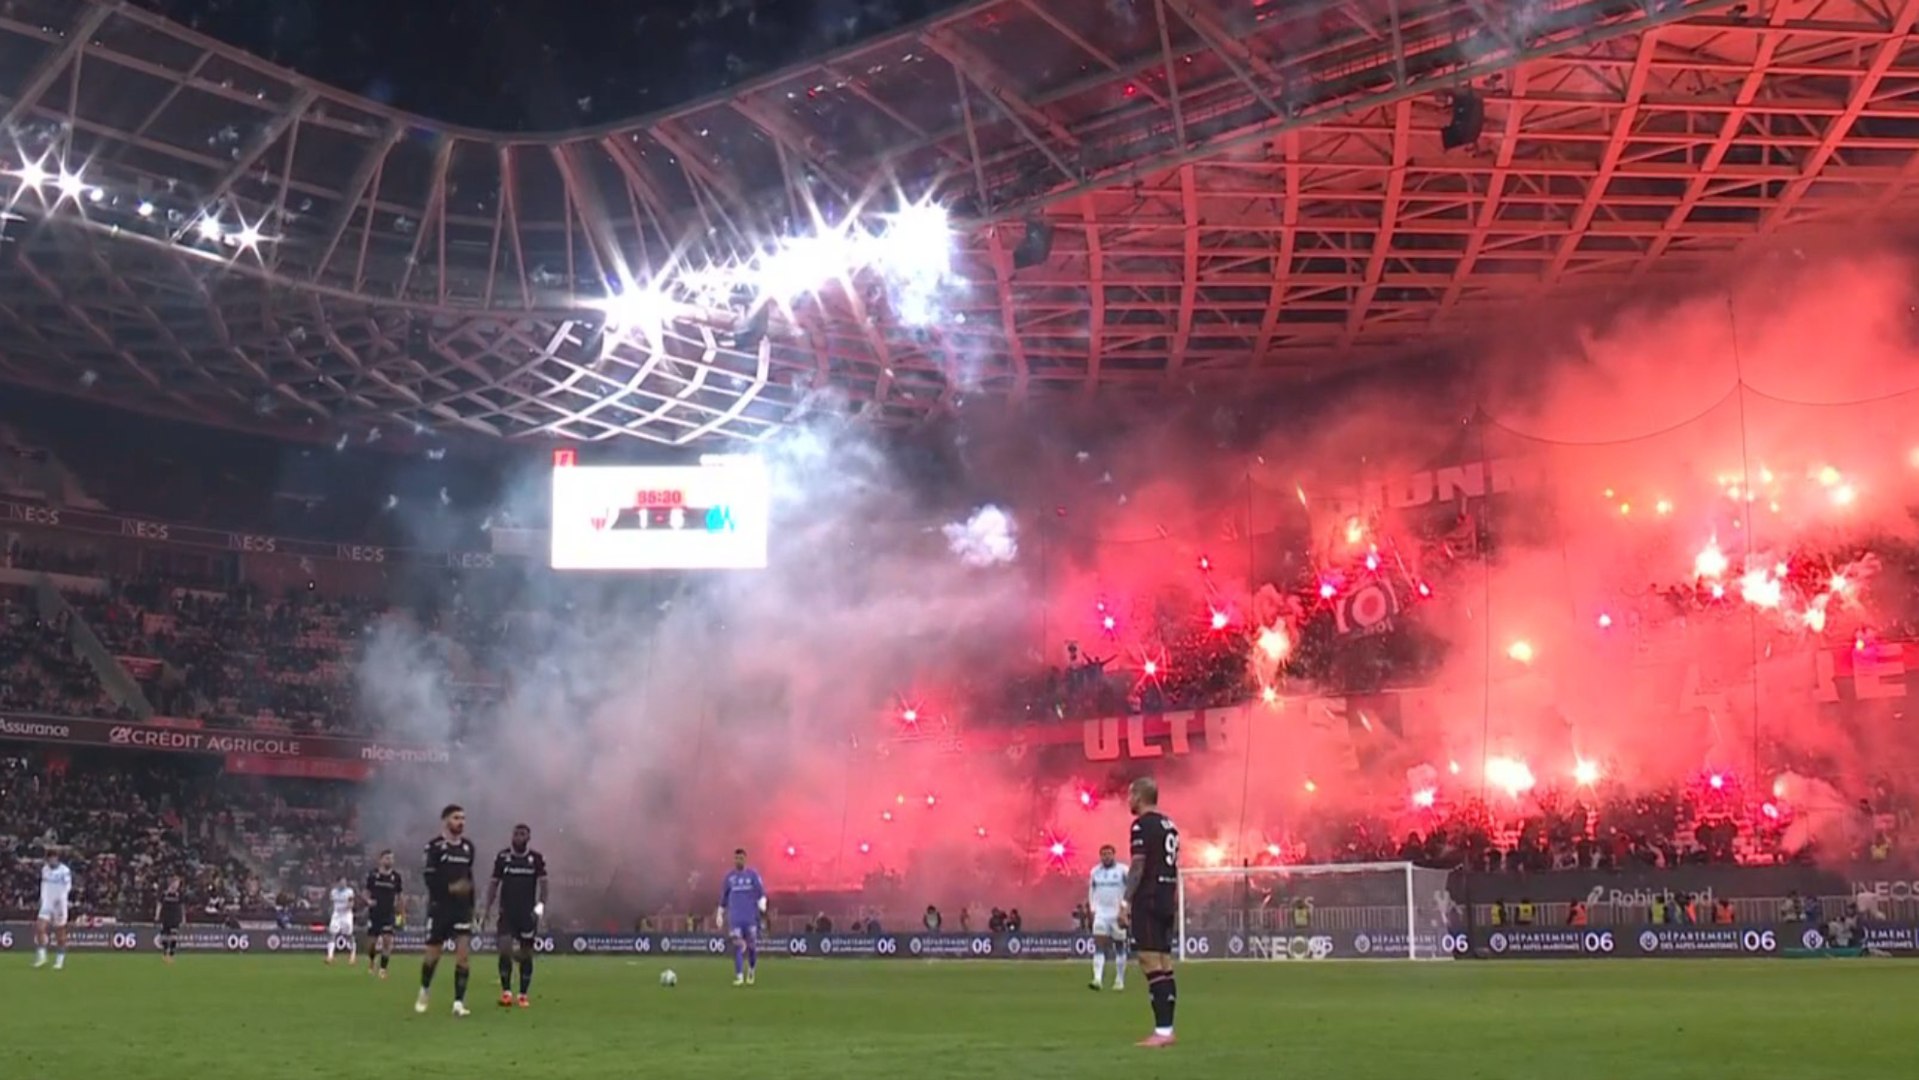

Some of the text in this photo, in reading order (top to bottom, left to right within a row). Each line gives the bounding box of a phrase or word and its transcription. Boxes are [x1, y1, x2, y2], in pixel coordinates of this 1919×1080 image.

[9, 505, 60, 525] INEOS
[121, 519, 169, 539] INEOS
[228, 534, 276, 553] INEOS
[336, 544, 385, 562] INEOS
[447, 550, 495, 569] INEOS
[0, 718, 70, 737] Assurance
[131, 729, 202, 748] CRÉDIT
[207, 736, 300, 755] AGRICOLE
[361, 744, 449, 762] nice-matin
[113, 932, 136, 948] 06
[227, 933, 249, 948] 06
[635, 938, 650, 951] 06
[1441, 934, 1468, 952] 06
[1508, 932, 1579, 942] DÉPARTEMENT
[1585, 932, 1614, 952] 06
[1659, 931, 1736, 941] DÉPARTEMENT
[1743, 930, 1776, 951] 06
[709, 938, 725, 952] 06
[790, 938, 807, 952] 06
[877, 938, 896, 953] 06
[971, 938, 992, 953] 06
[1075, 938, 1096, 953] 06
[1186, 937, 1209, 953] 06
